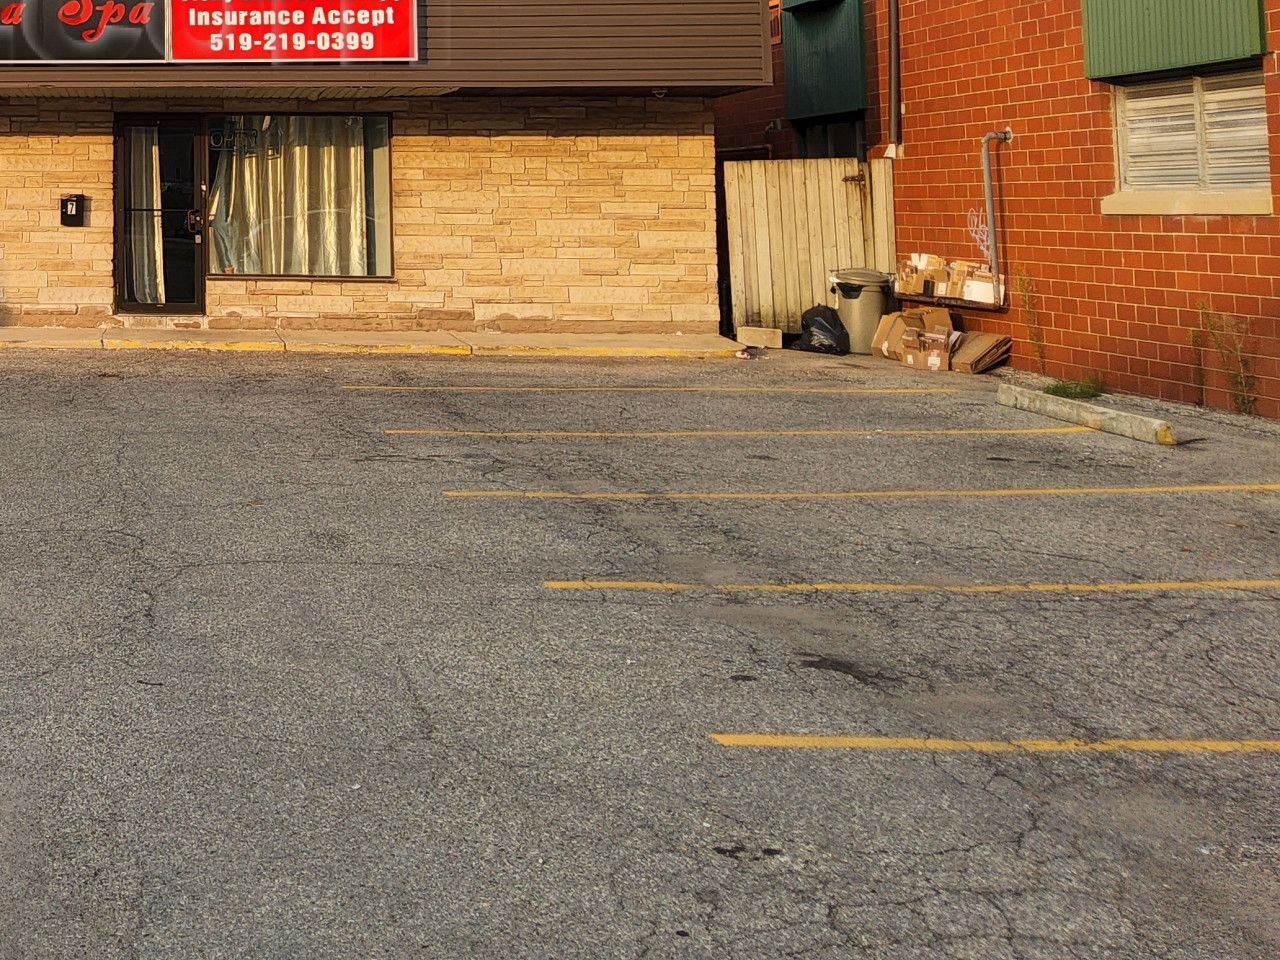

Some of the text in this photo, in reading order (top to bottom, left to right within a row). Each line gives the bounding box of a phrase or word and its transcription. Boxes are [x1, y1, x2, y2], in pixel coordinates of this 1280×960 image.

[189, 6, 395, 26] Insurance Accept
[209, 31, 375, 51] 519-219-0399
